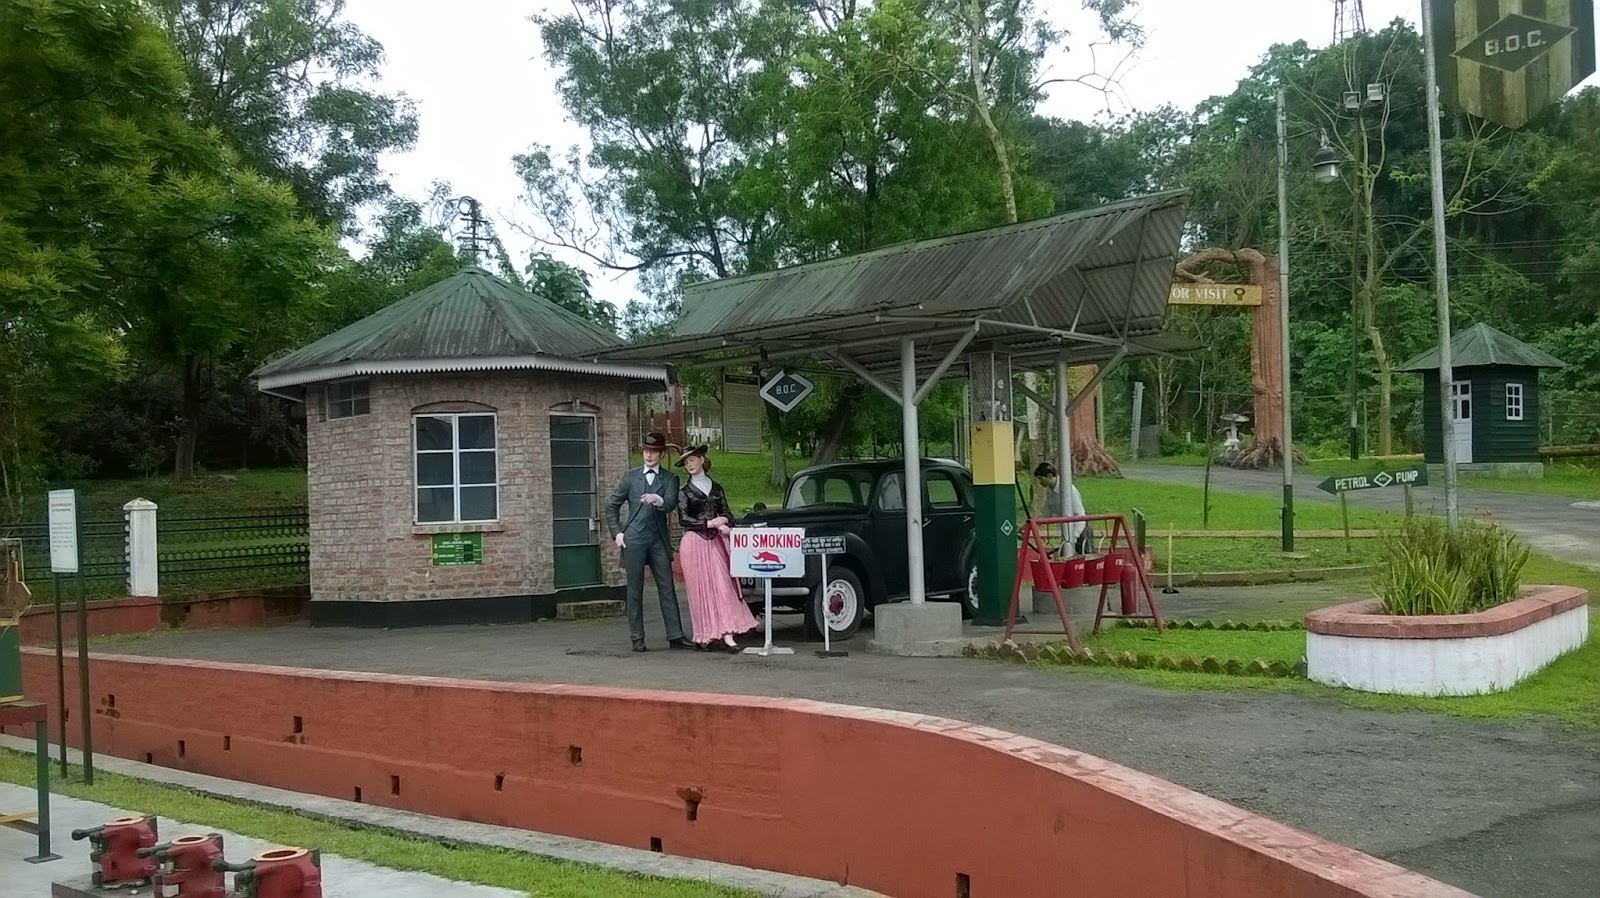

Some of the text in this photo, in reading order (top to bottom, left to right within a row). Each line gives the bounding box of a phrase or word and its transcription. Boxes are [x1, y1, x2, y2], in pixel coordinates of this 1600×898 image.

[1485, 30, 1547, 56] B.O.C.
[776, 383, 796, 395] B.O.C
[1335, 470, 1418, 490] PETROL PUMP
[734, 534, 748, 548] NO
[752, 534, 801, 548] SMOKING
